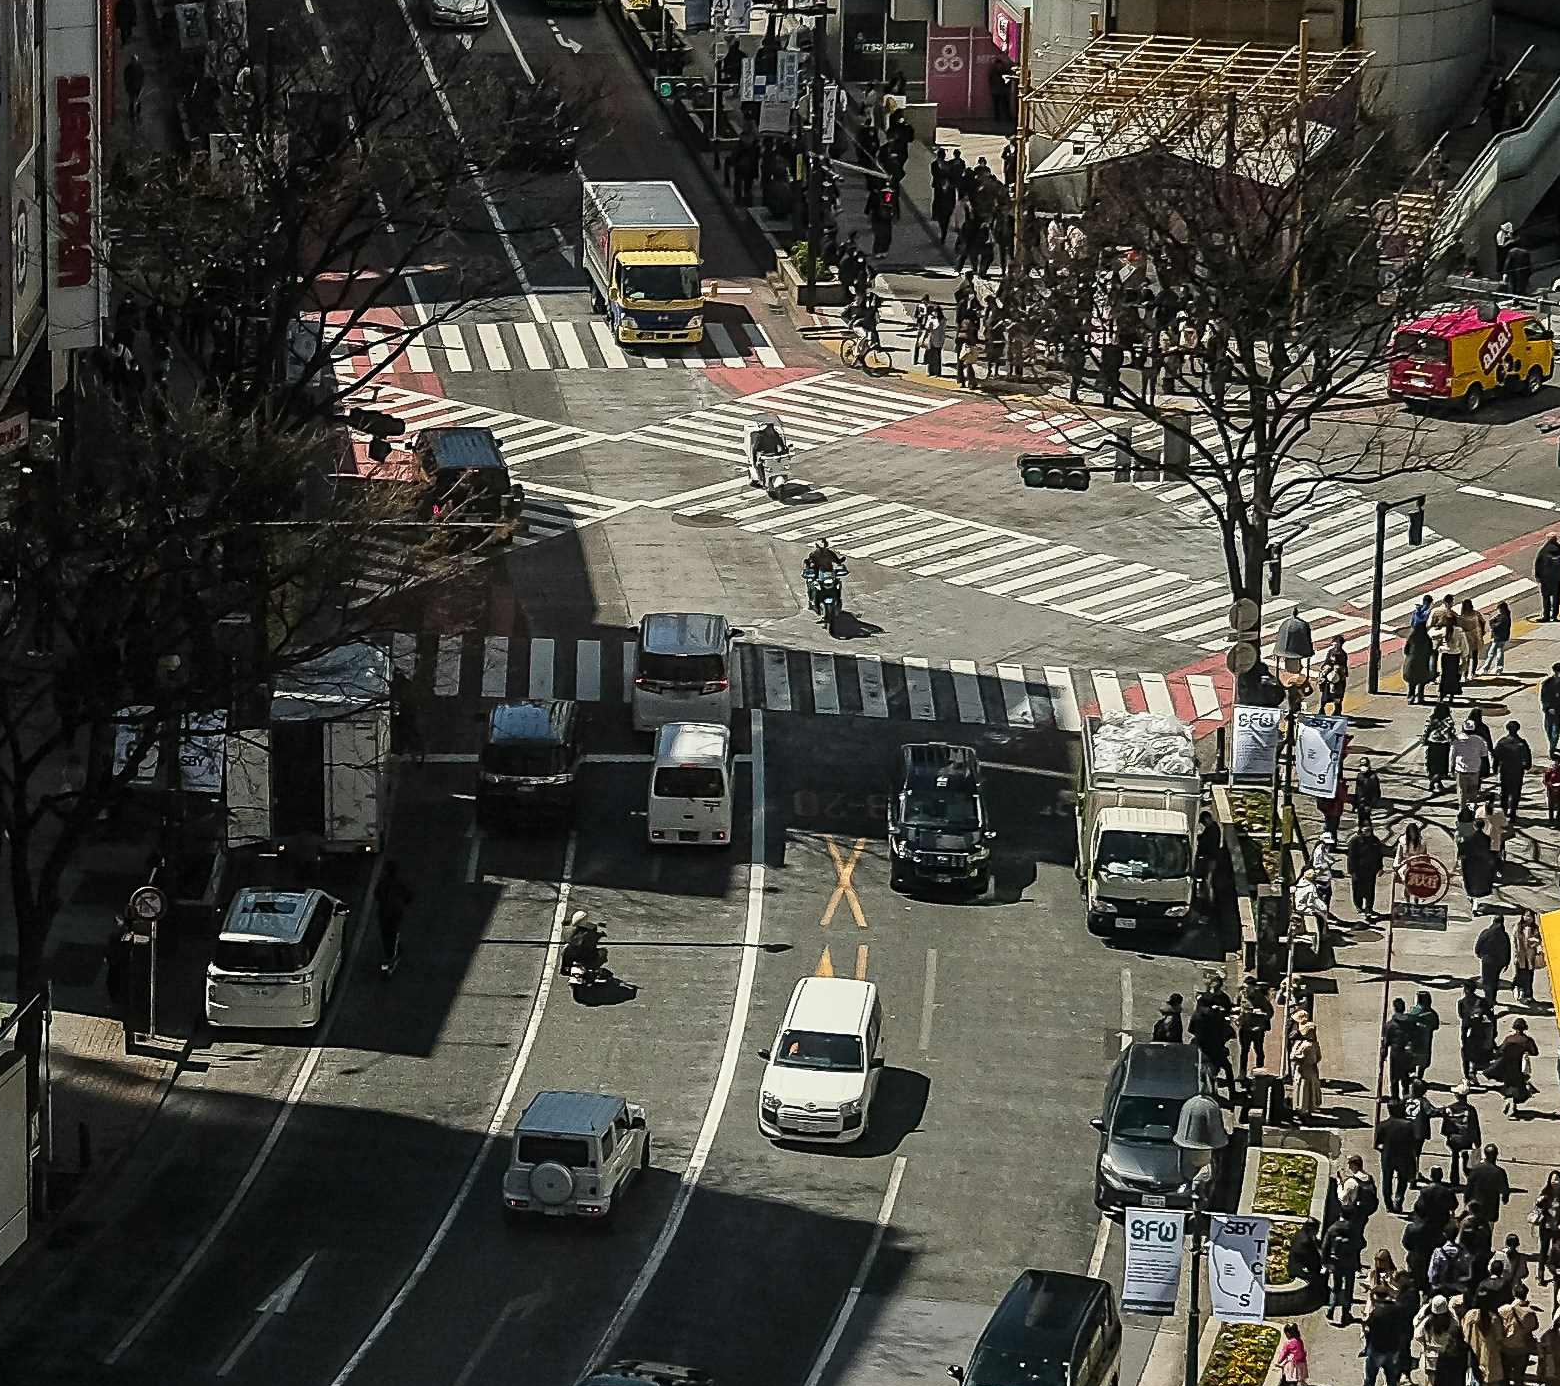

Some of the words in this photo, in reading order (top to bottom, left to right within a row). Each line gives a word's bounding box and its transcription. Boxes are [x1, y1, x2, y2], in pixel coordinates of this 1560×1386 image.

[1307, 715, 1340, 730] SBY
[1129, 1216, 1178, 1245] SFW
[1224, 1219, 1257, 1236] SBY
